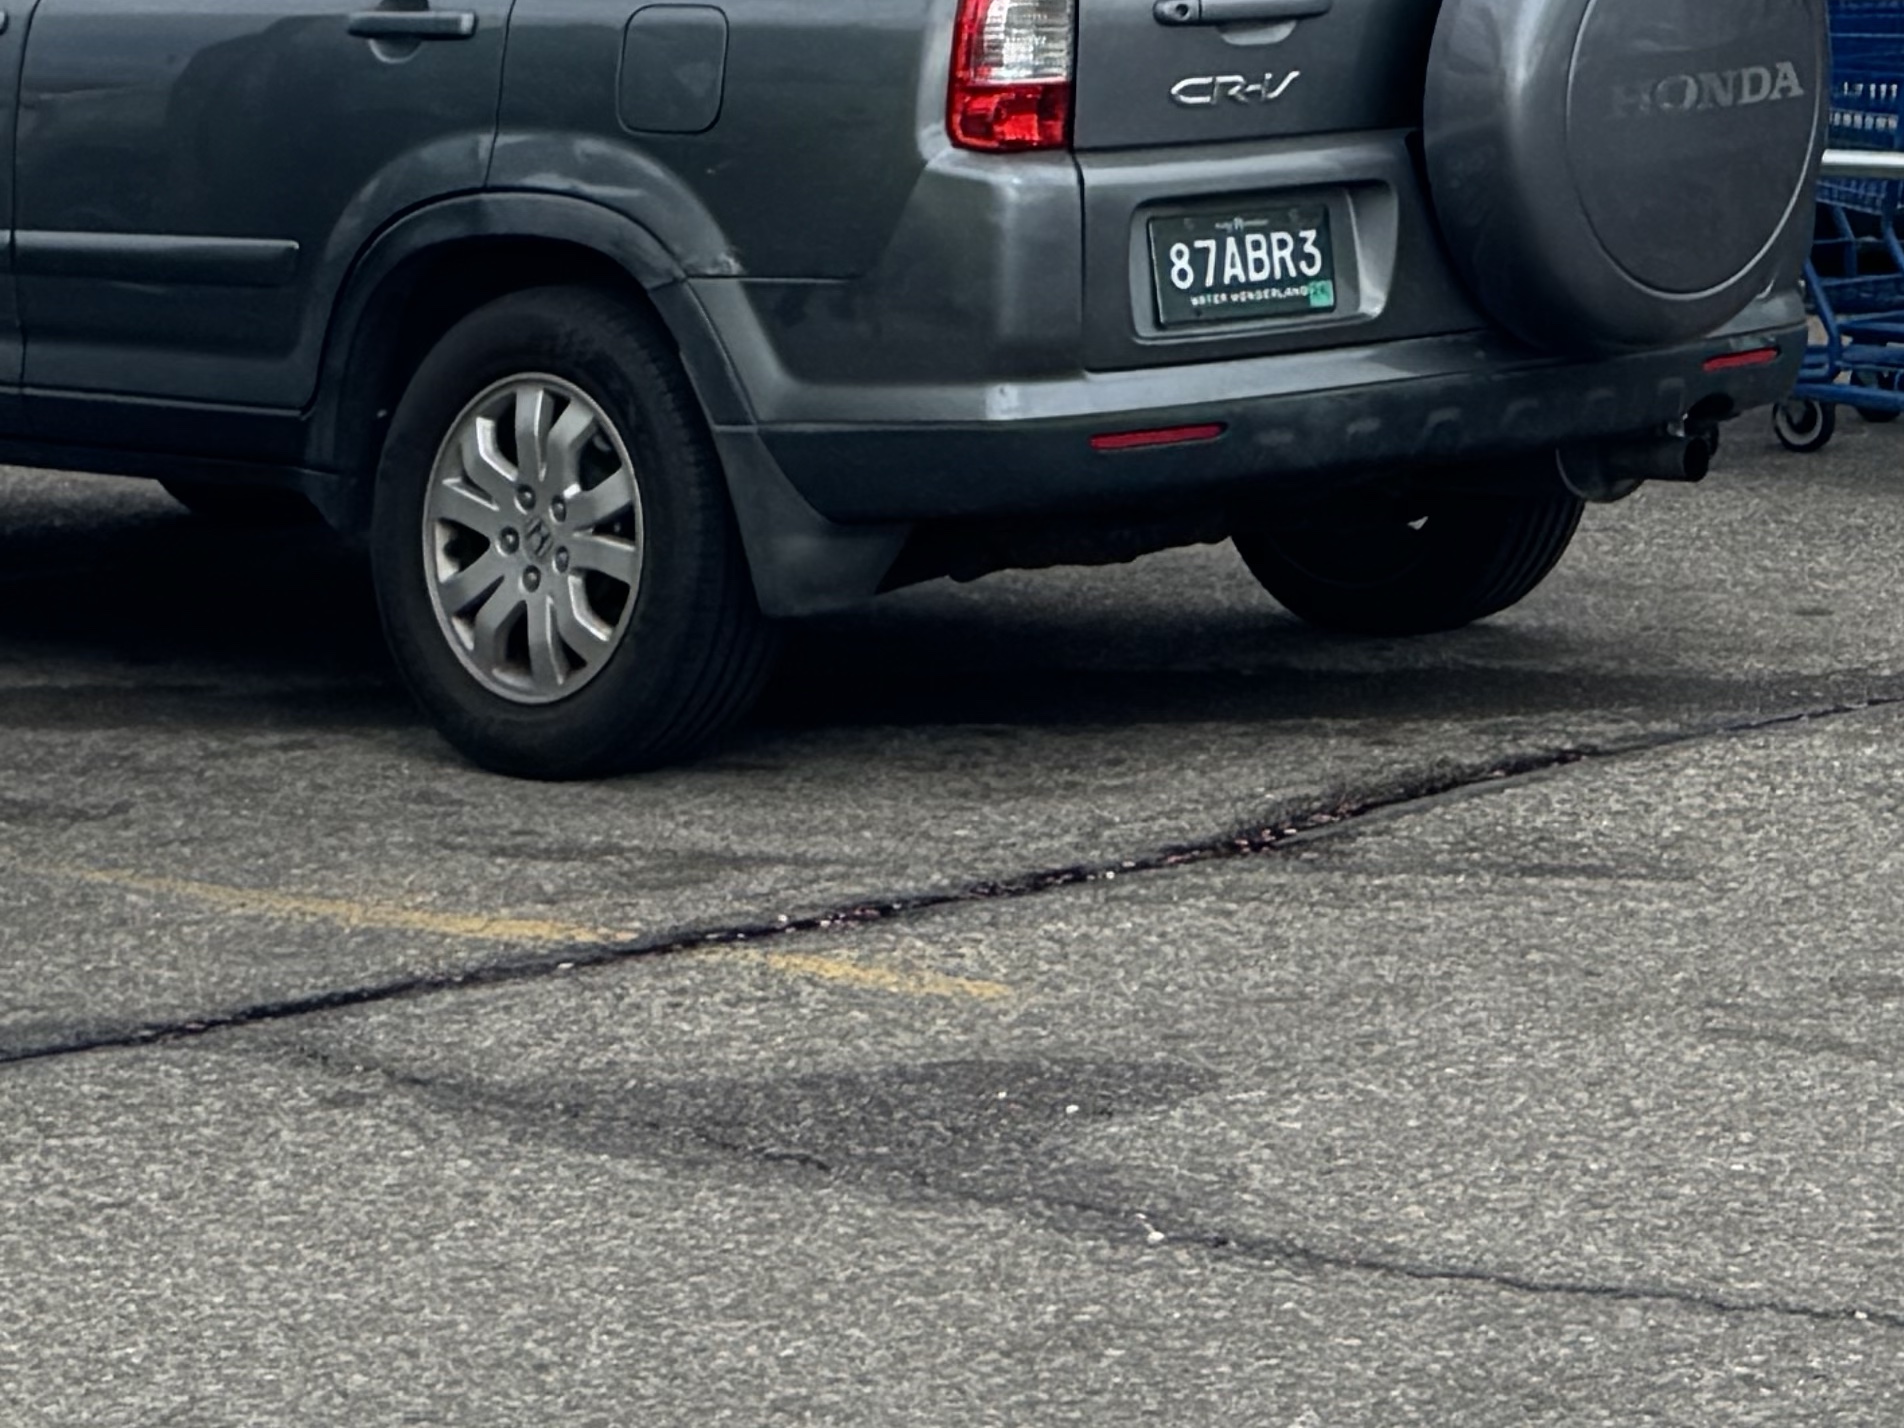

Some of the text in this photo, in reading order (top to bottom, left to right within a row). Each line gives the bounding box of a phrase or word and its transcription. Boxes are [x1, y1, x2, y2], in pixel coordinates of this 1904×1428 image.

[1171, 71, 1300, 105] CR-V
[1612, 61, 1804, 120] HONDA
[1169, 229, 1322, 290] 87ABR3
